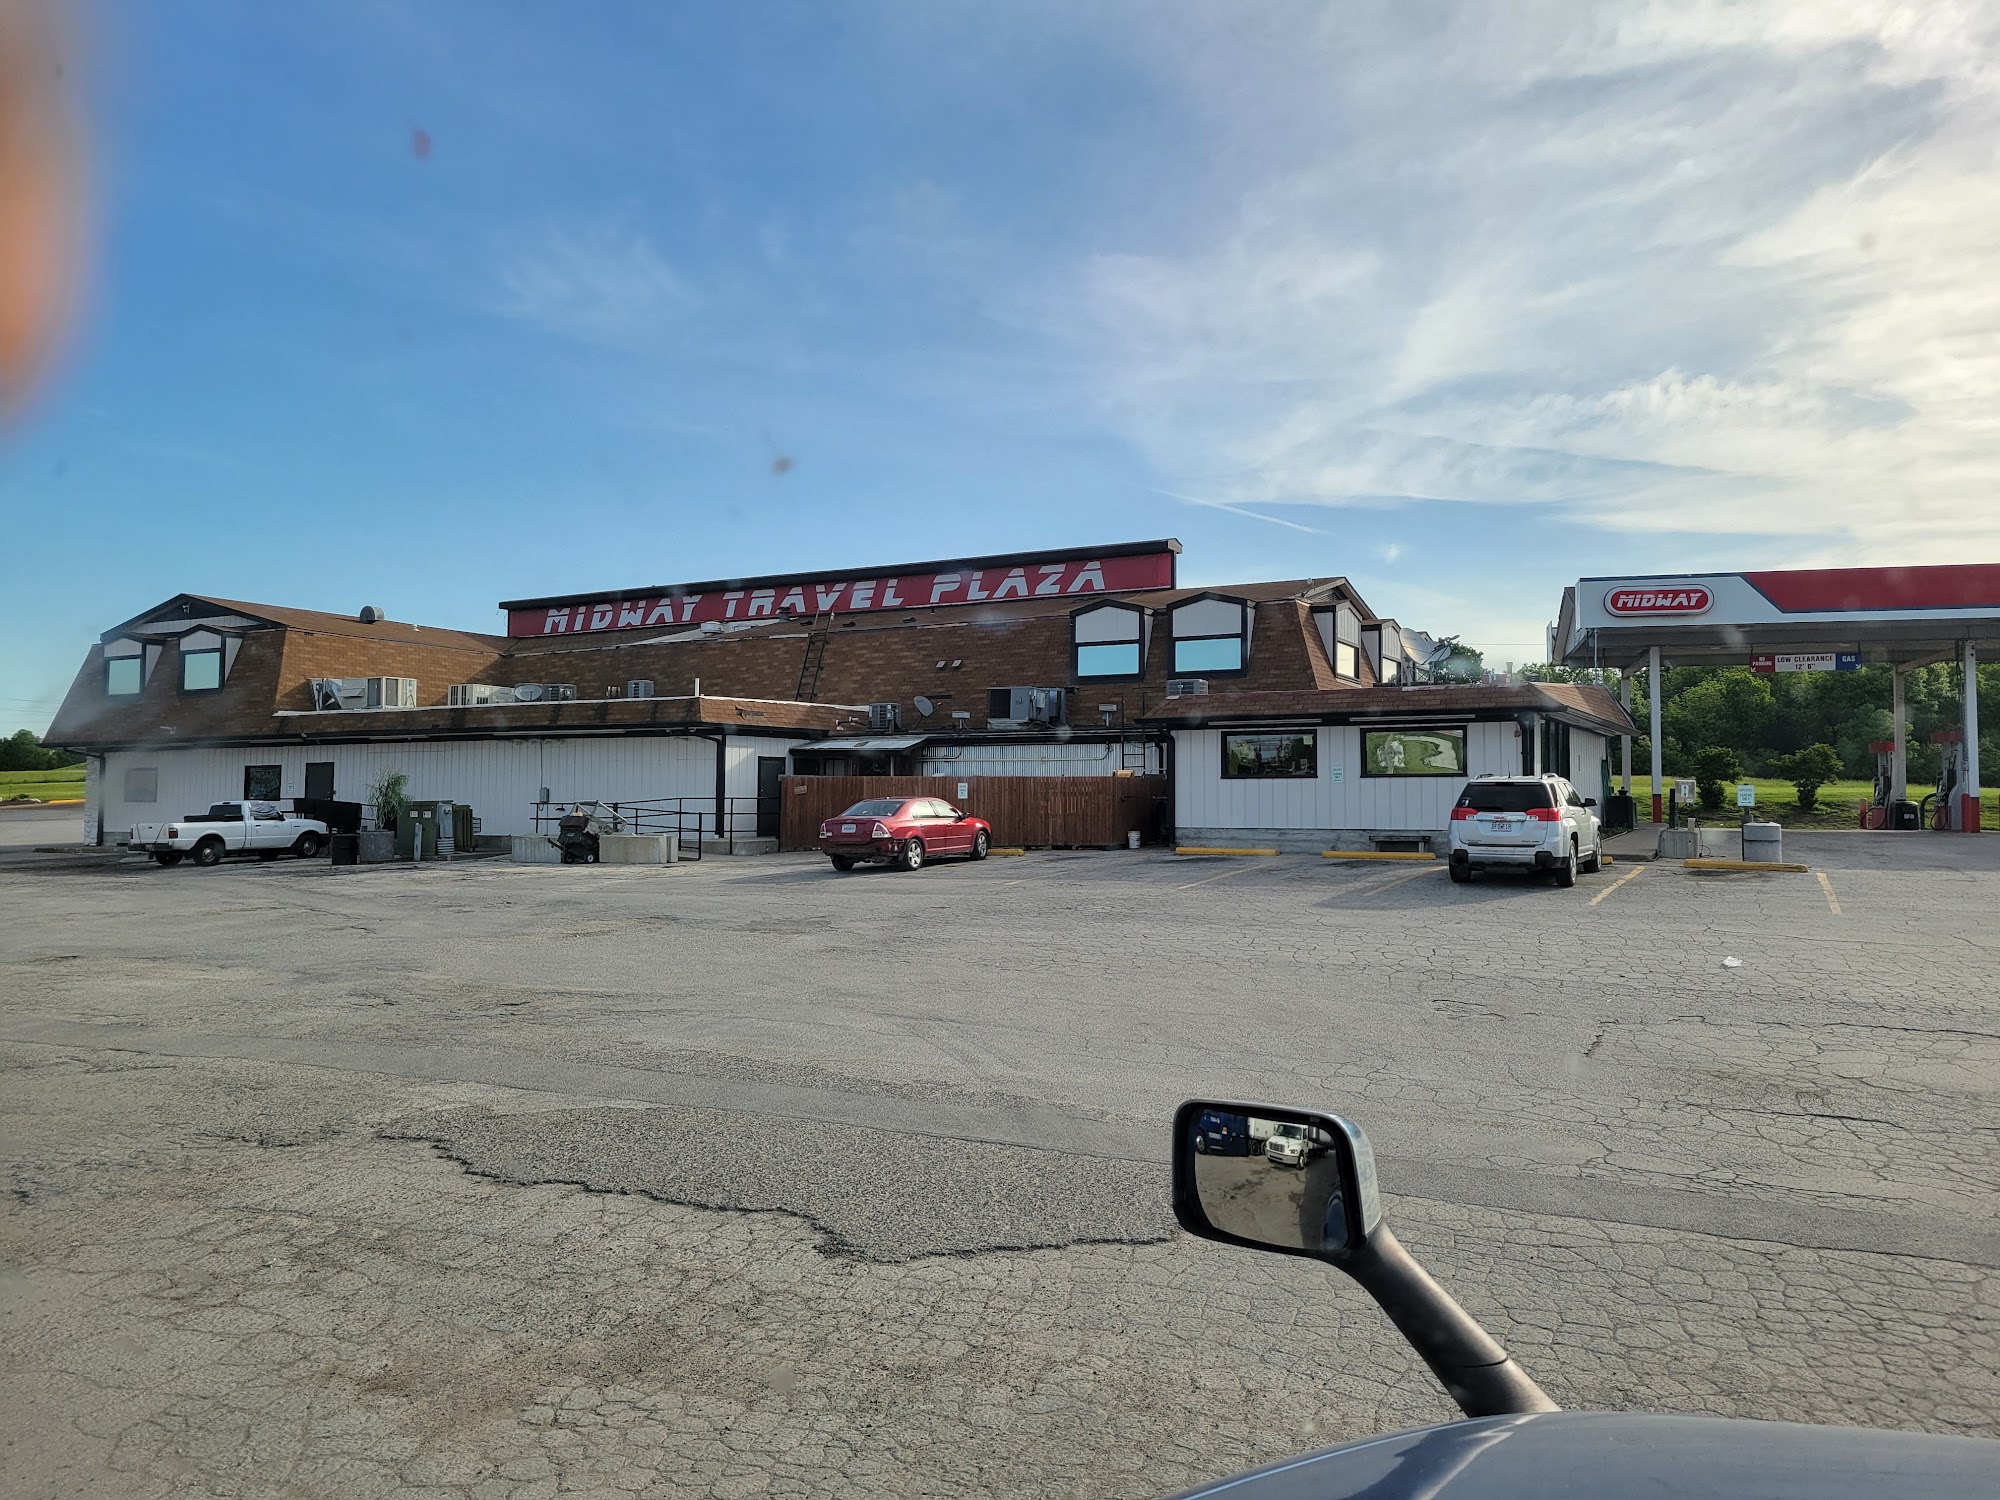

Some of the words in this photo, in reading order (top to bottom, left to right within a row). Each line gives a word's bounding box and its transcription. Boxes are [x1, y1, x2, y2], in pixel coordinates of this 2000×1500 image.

[543, 594, 703, 634] MIDWAY
[722, 578, 904, 618] TRAVEL
[929, 560, 1105, 604] PLAZA
[1616, 592, 1703, 608] MIDWAY
[1794, 655, 1833, 663] CLEARANCE
